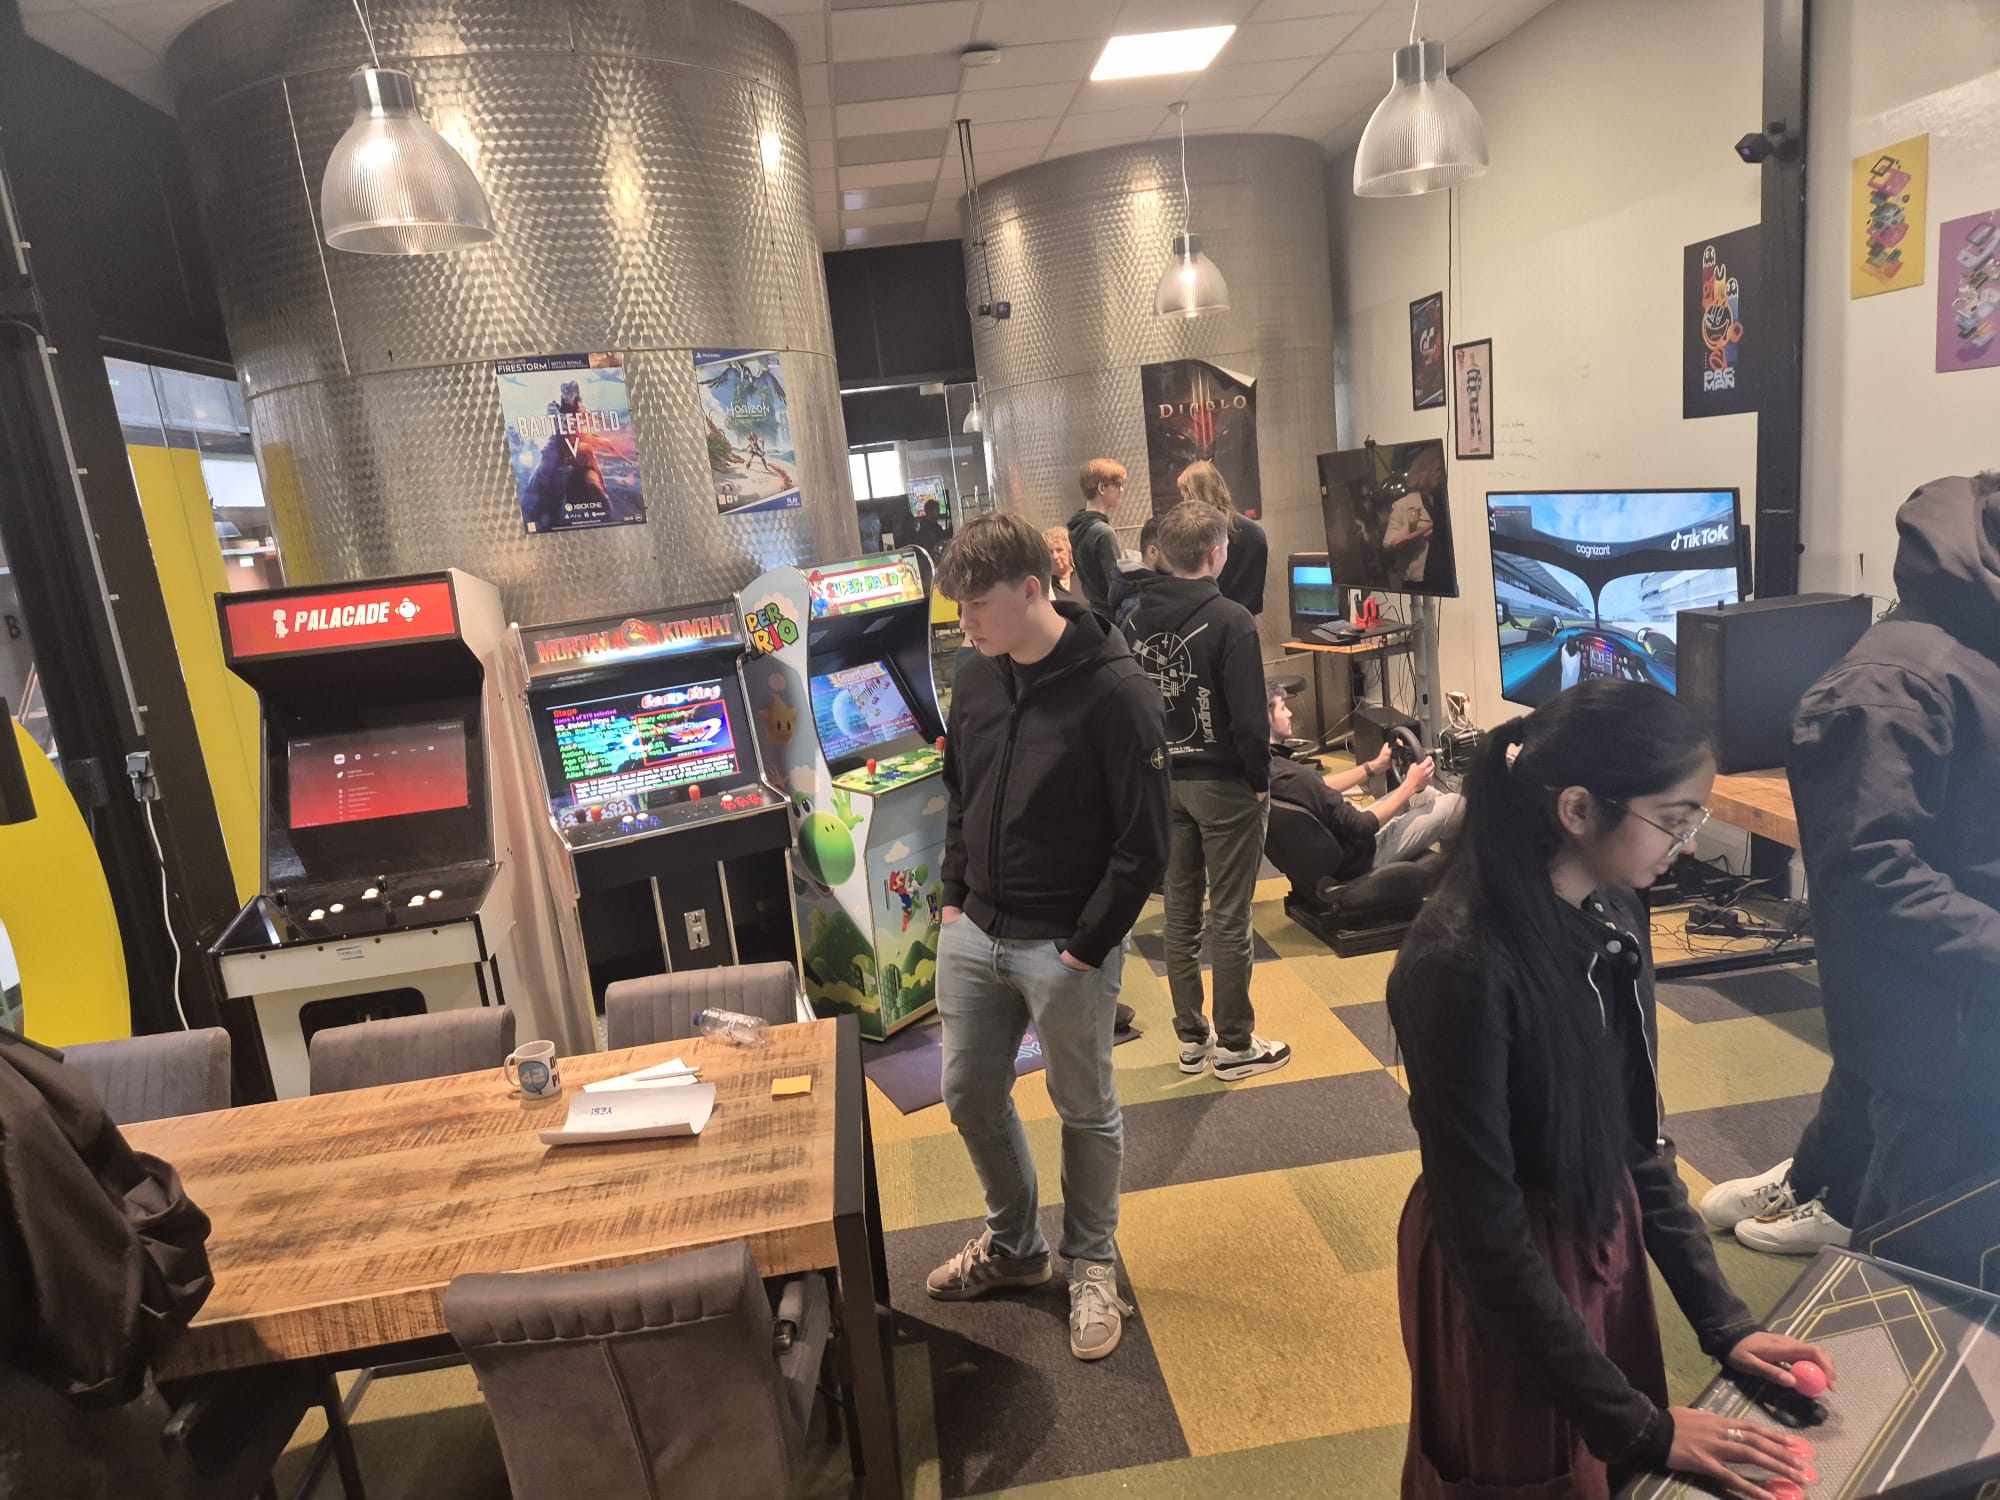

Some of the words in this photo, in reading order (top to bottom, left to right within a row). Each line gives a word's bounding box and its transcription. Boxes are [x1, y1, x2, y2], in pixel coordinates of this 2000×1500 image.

[497, 363, 548, 374] FIRESTORM
[1158, 394, 1247, 419] DIABLO
[518, 410, 620, 438] BATTLEFIELD
[564, 437, 580, 458] V
[573, 503, 589, 511] XBOX
[1683, 524, 1729, 549] TikTok
[1576, 543, 1611, 558] cognizant
[826, 577, 863, 598] SUPER
[864, 572, 899, 592] MARIO
[294, 601, 392, 632] PALACADE
[745, 602, 784, 634] PER
[535, 632, 609, 663] MORTAL
[660, 613, 733, 642] KOMBAT
[752, 617, 799, 655] RIO
[553, 709, 578, 718] Stage
[522, 1068, 545, 1085] 42
